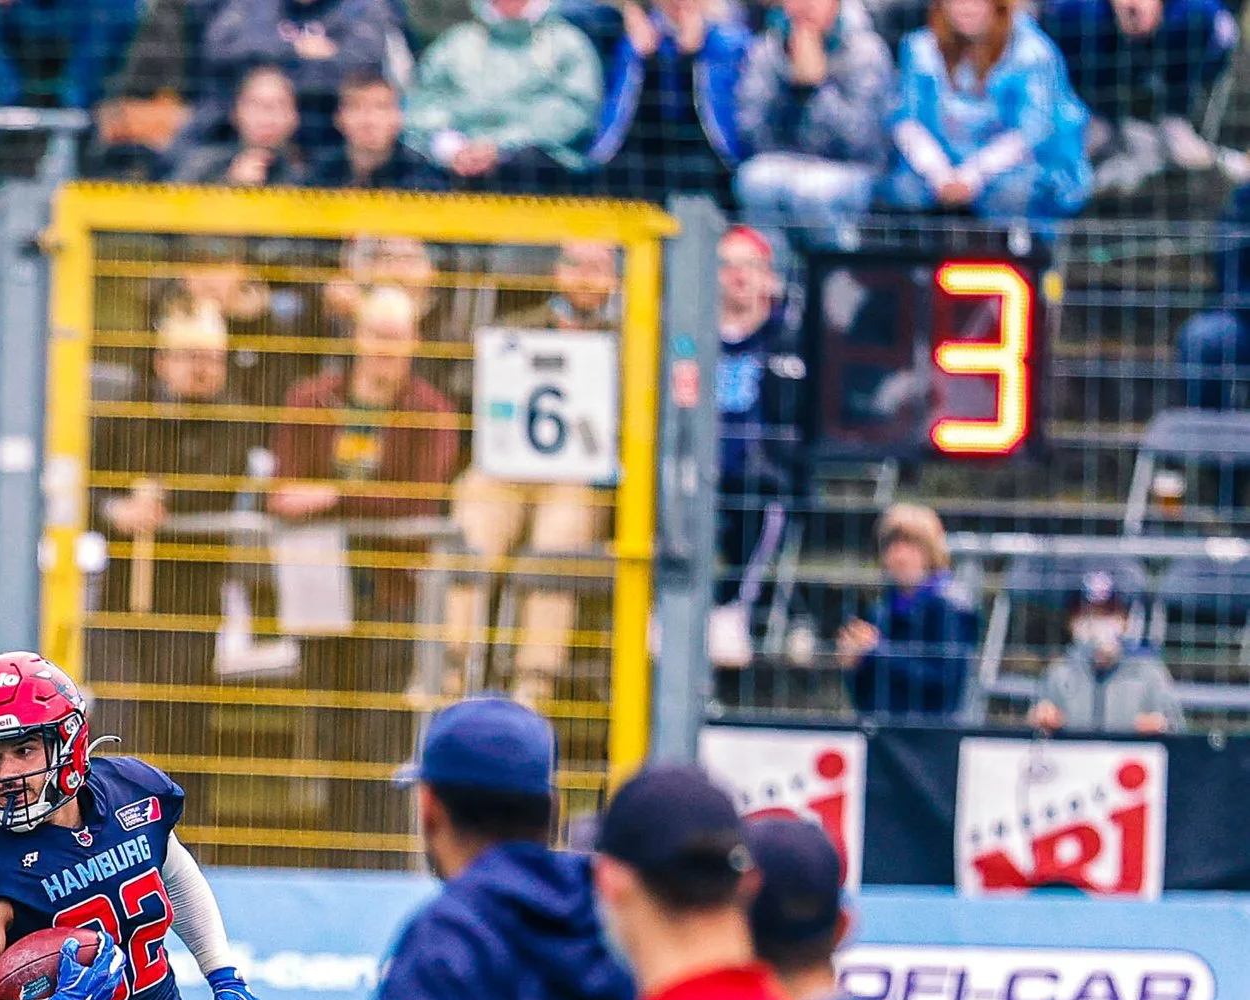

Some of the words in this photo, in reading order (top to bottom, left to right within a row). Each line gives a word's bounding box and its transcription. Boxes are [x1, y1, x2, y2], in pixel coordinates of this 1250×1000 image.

[932, 262, 1031, 454] 3
[525, 385, 568, 454] 6
[41, 834, 152, 902] HAMBURG
